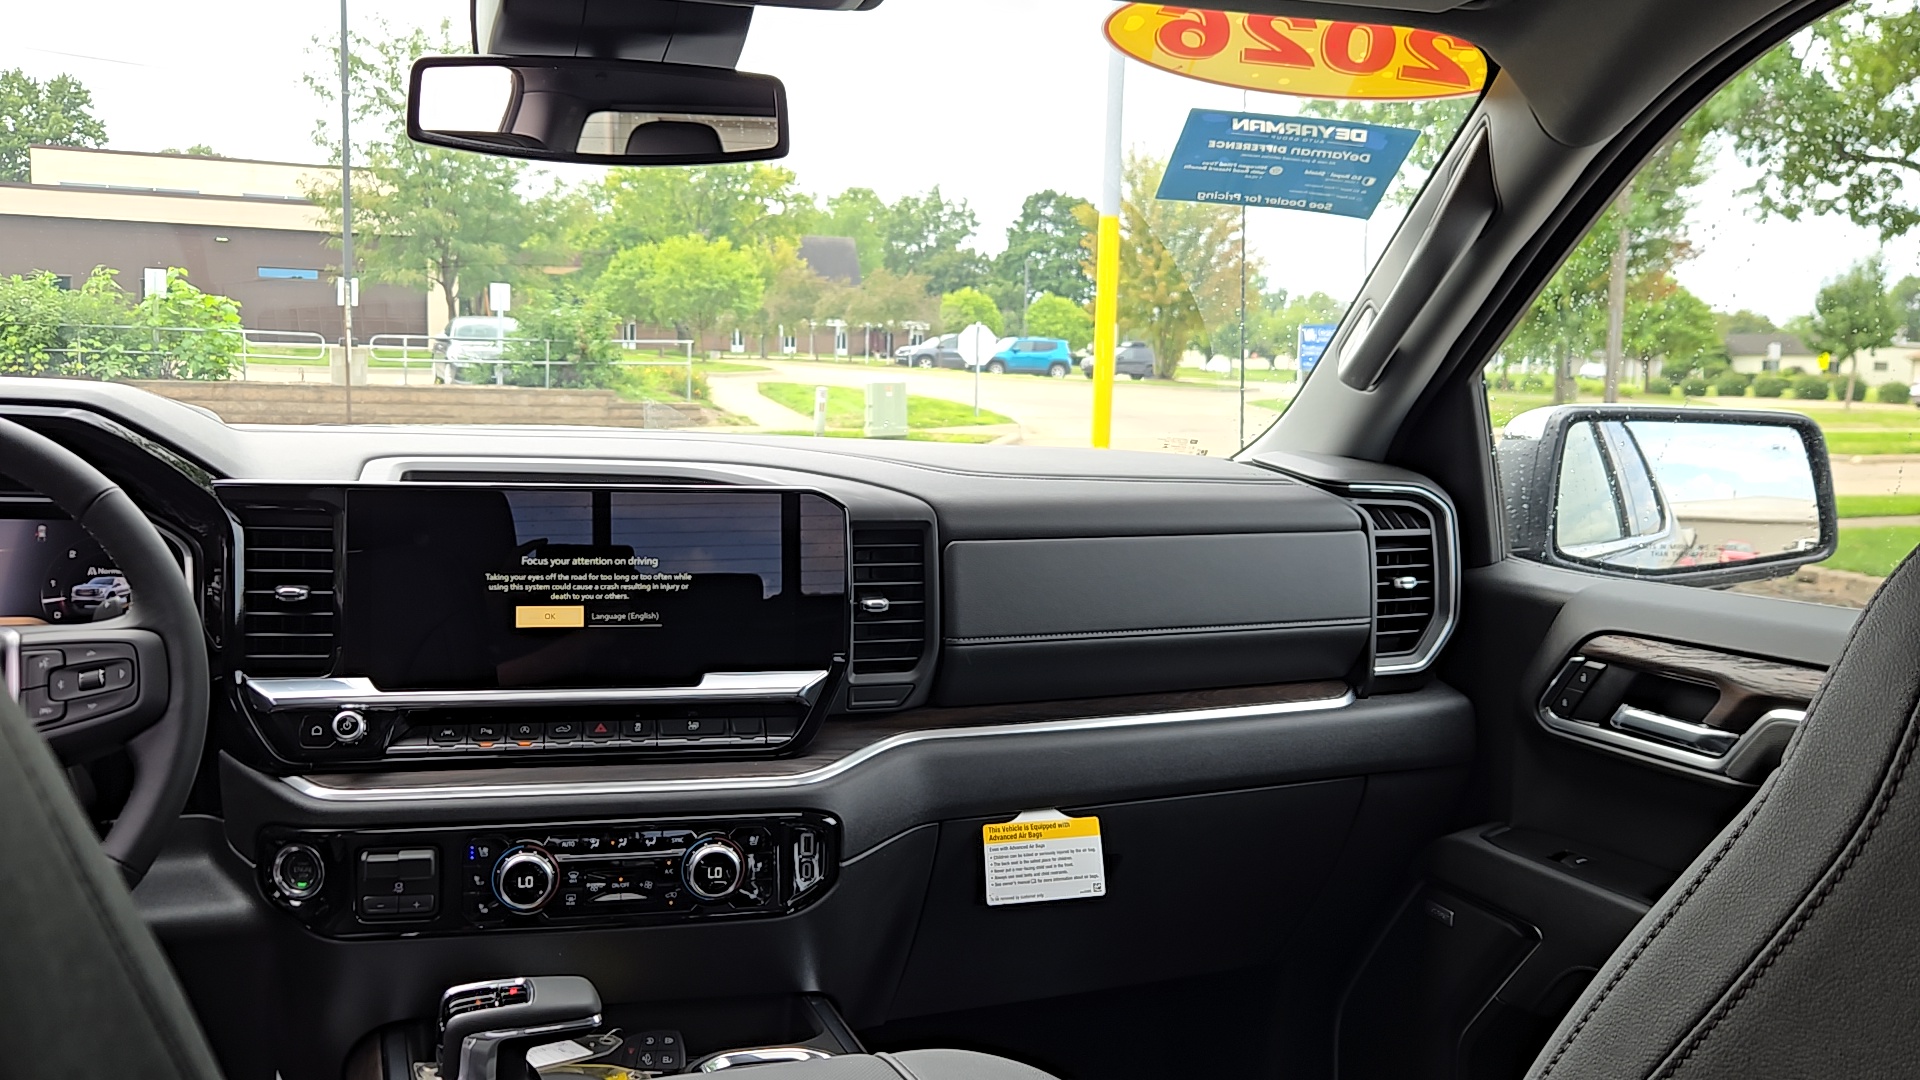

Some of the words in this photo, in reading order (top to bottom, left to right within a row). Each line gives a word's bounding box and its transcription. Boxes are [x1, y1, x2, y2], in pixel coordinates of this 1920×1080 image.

[522, 556, 548, 566] Focus
[550, 557, 569, 568] your
[572, 556, 612, 565] attention
[615, 558, 626, 566] on
[628, 556, 658, 568] driving
[486, 573, 509, 582] Taking
[510, 574, 526, 582] your
[527, 574, 544, 582] eyes
[545, 573, 556, 581] off
[558, 573, 569, 581] the
[571, 573, 587, 581] road
[588, 573, 598, 581] for
[600, 573, 612, 581] too
[614, 573, 629, 582] long
[654, 573, 672, 581] often
[674, 573, 691, 581] while
[489, 583, 508, 592] using
[510, 583, 523, 591] this
[525, 584, 550, 592] system
[552, 583, 571, 591] could
[600, 583, 619, 591] crash
[621, 583, 651, 592] resulting
[653, 583, 659, 591] in
[661, 583, 679, 592] injury
[581, 594, 594, 602] you
[592, 613, 626, 621] Language
[628, 612, 659, 621] (English)
[1002, 824, 1022, 832] Vehicle
[989, 833, 1017, 841] Advanced
[707, 866, 722, 879] LO
[518, 876, 534, 888] LO
